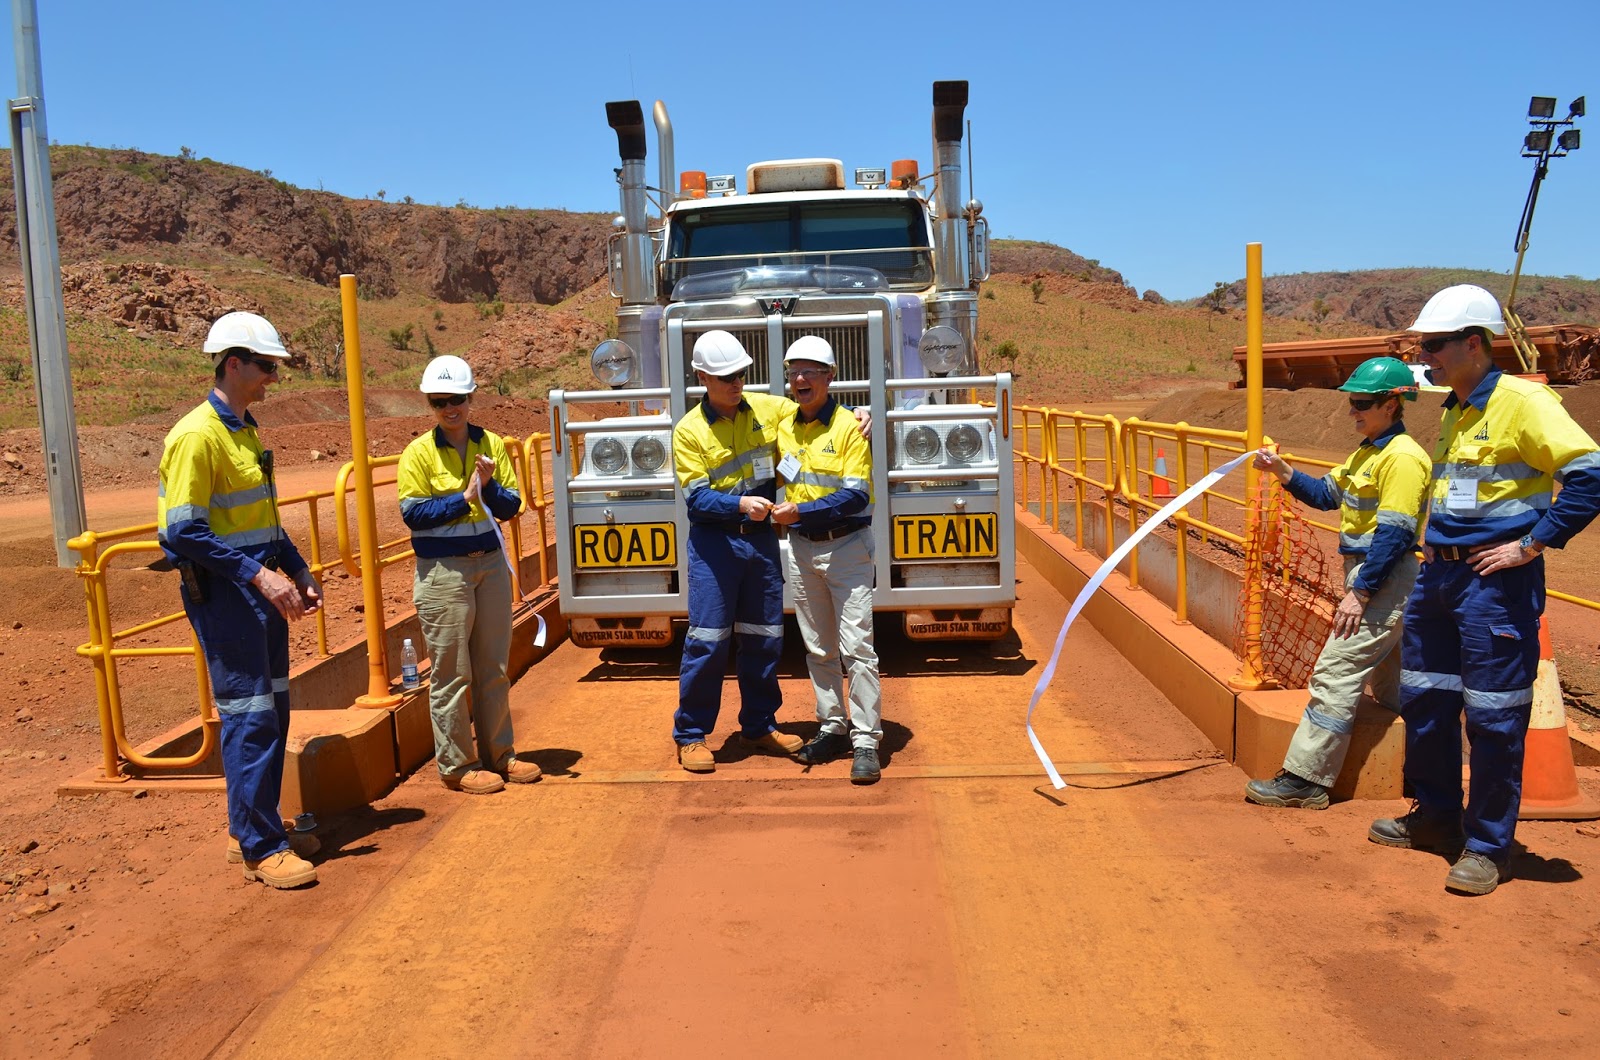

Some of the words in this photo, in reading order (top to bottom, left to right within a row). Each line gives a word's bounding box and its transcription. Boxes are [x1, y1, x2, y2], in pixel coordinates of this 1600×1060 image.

[580, 528, 669, 563] ROAD
[897, 518, 993, 554] TRAIN
[576, 631, 612, 641] WESTERN
[614, 630, 633, 640] STAR
[635, 630, 665, 640] TRUCKS
[910, 624, 947, 633] WESTERN
[949, 623, 969, 632] STAR
[972, 622, 1002, 632] TRUCKS
